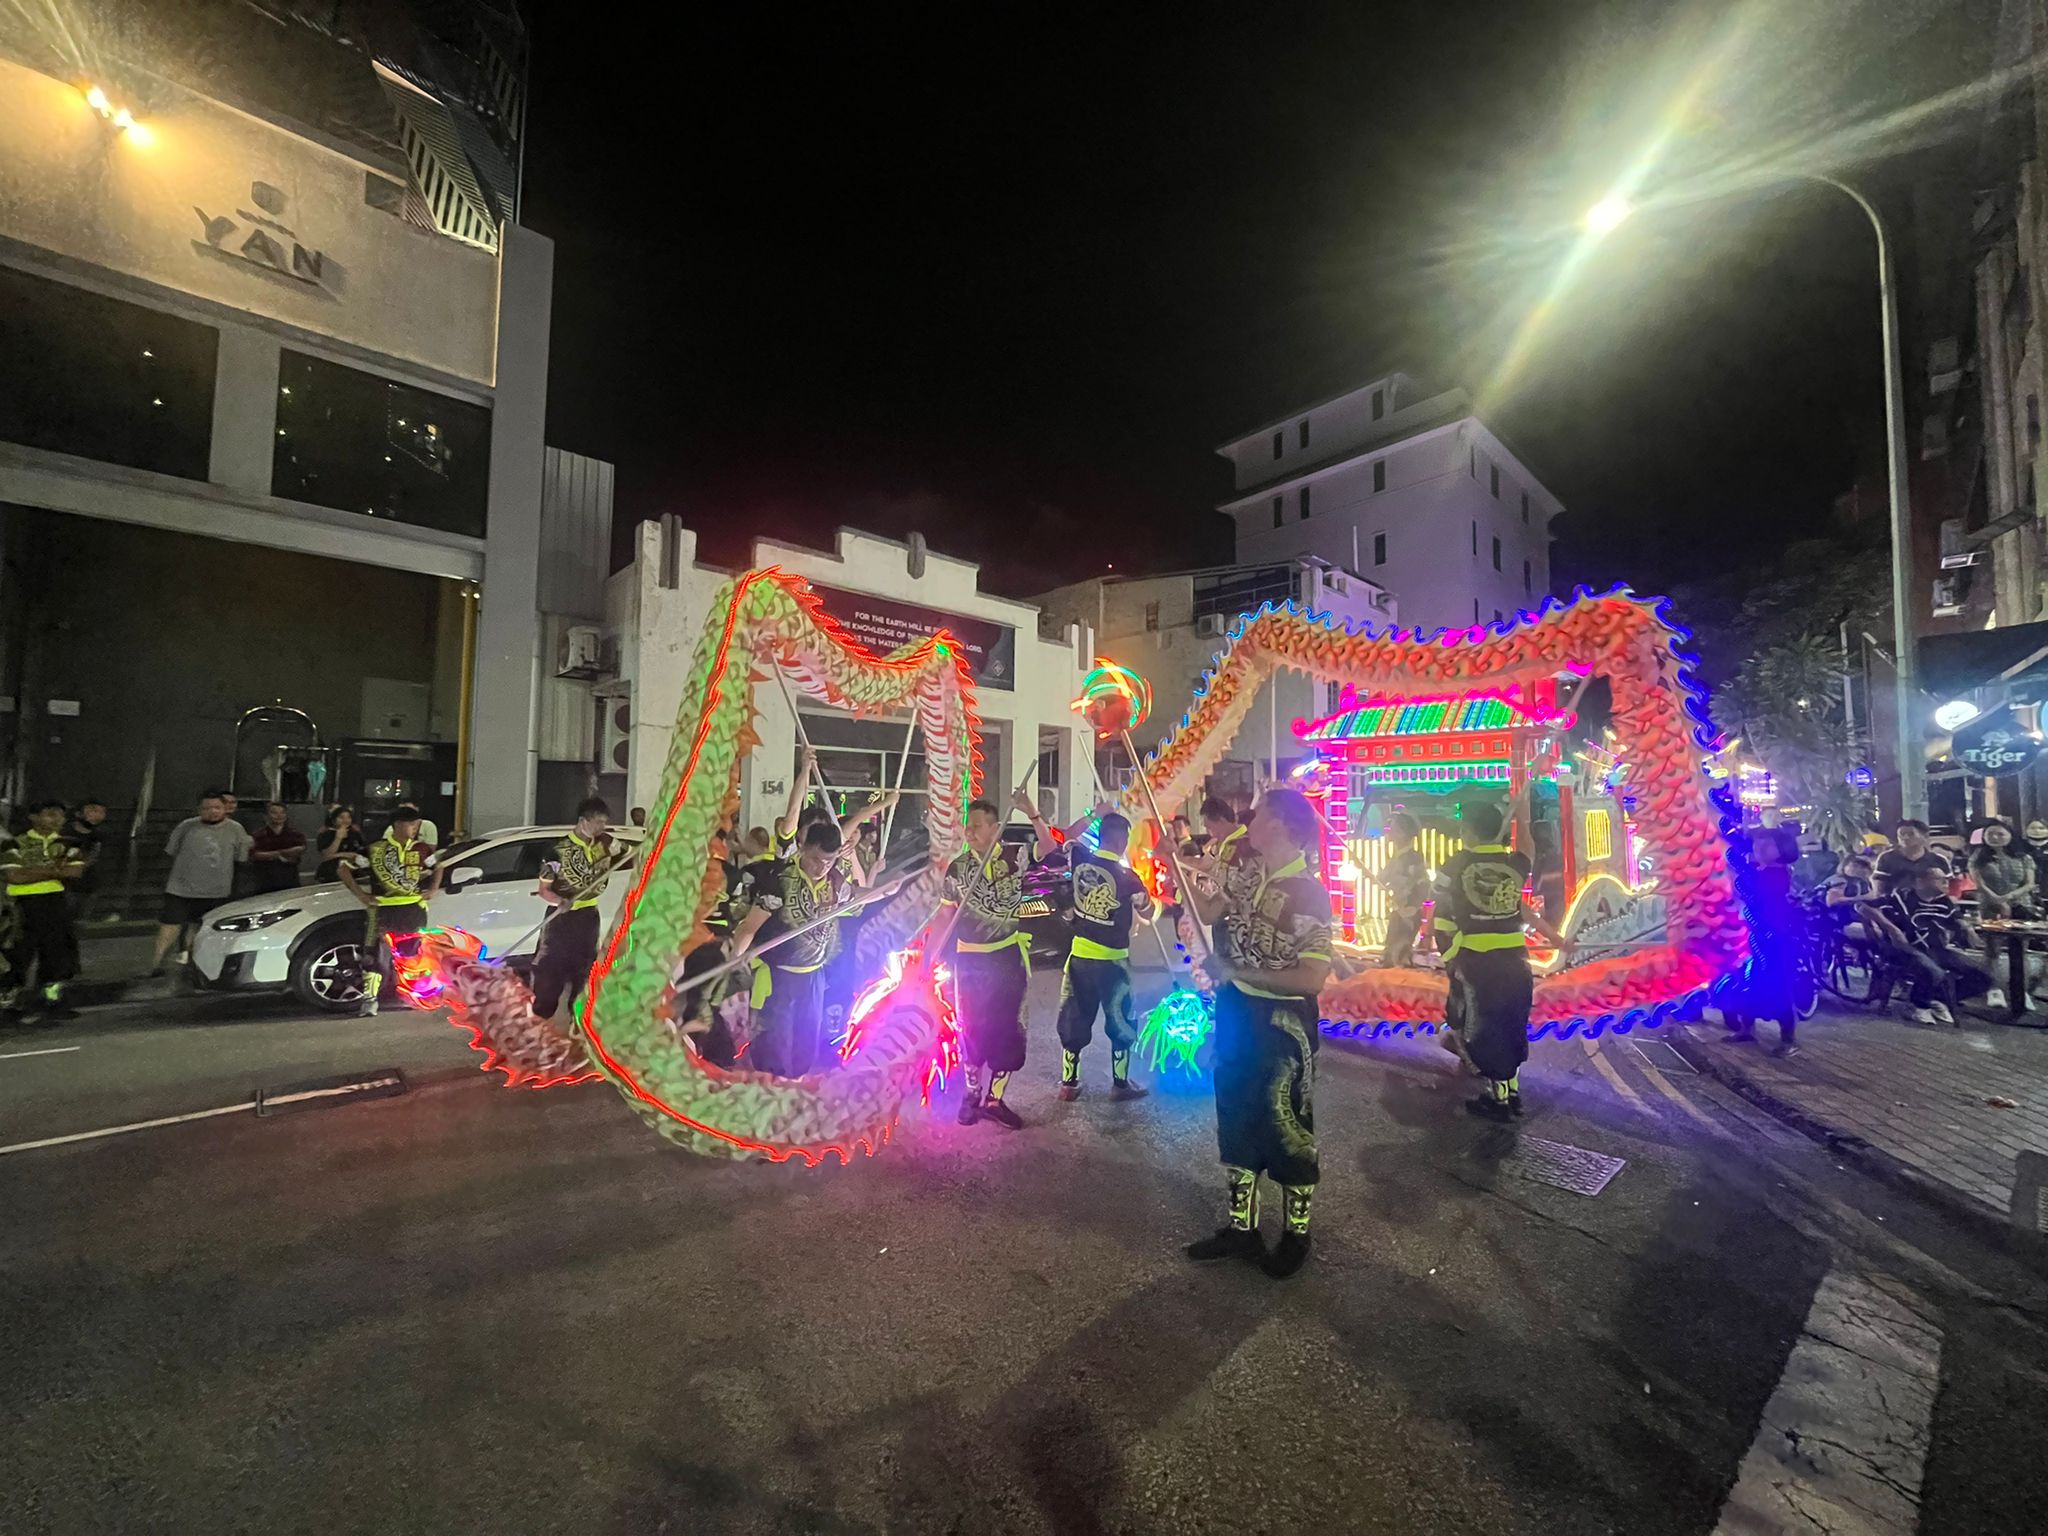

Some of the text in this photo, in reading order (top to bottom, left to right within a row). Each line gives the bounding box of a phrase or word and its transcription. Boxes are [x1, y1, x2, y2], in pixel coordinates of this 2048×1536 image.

[191, 205, 323, 280] YAN
[852, 622, 895, 637] KNOWLEDGE
[896, 631, 906, 639] OF
[855, 611, 870, 621] FOR
[871, 614, 884, 624] THE
[885, 617, 907, 629] EARTH
[908, 621, 923, 632] WILL
[863, 636, 877, 645] THE
[1964, 747, 2027, 769] Tiger
[761, 780, 784, 795] 154
